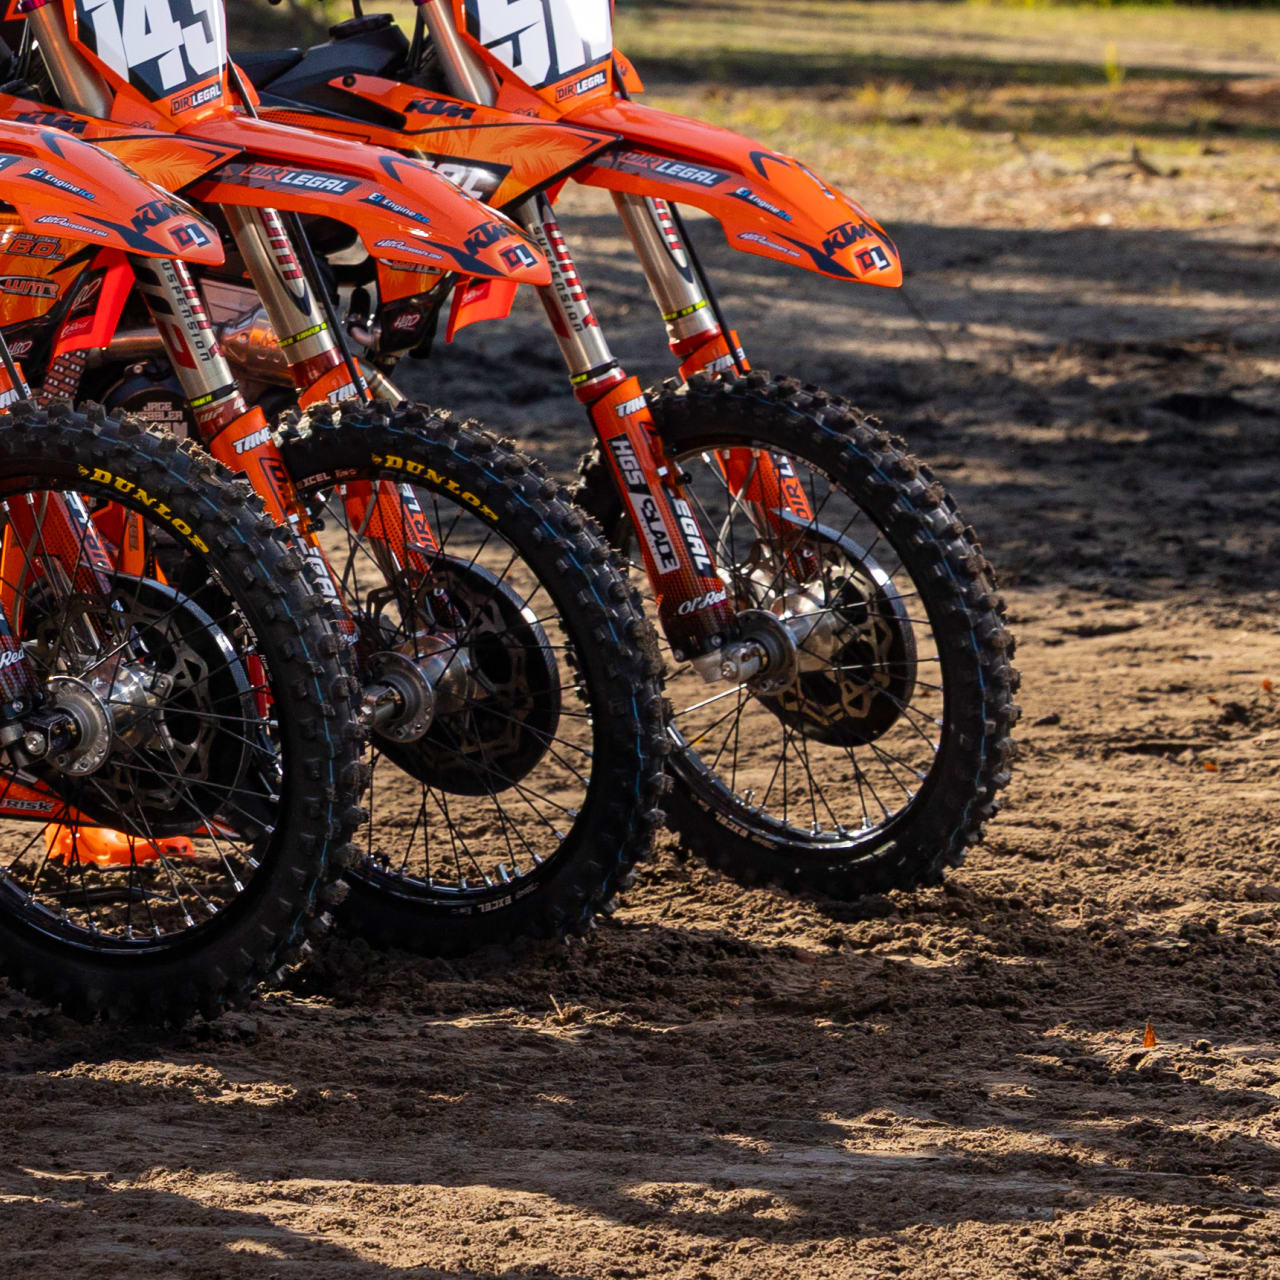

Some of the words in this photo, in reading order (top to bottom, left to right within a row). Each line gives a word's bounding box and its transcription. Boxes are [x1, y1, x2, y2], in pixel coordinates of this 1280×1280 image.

[192, 84, 222, 106] LEGAL
[576, 71, 607, 92] LEGAL
[403, 97, 478, 120] KTM
[246, 163, 287, 182] DIRT
[280, 169, 349, 193] LEGAL
[655, 161, 721, 186] LEGAL
[131, 200, 186, 234] KTM
[169, 223, 206, 249] DL
[462, 221, 519, 257] KTM
[821, 221, 873, 256] KTM
[533, 225, 583, 333] SUSPENSION
[160, 258, 211, 364] USPENSION
[610, 438, 646, 486] HGS
[384, 453, 499, 521] DUNLOP
[90, 465, 210, 554] DUNLOP
[640, 496, 679, 571] SLADE
